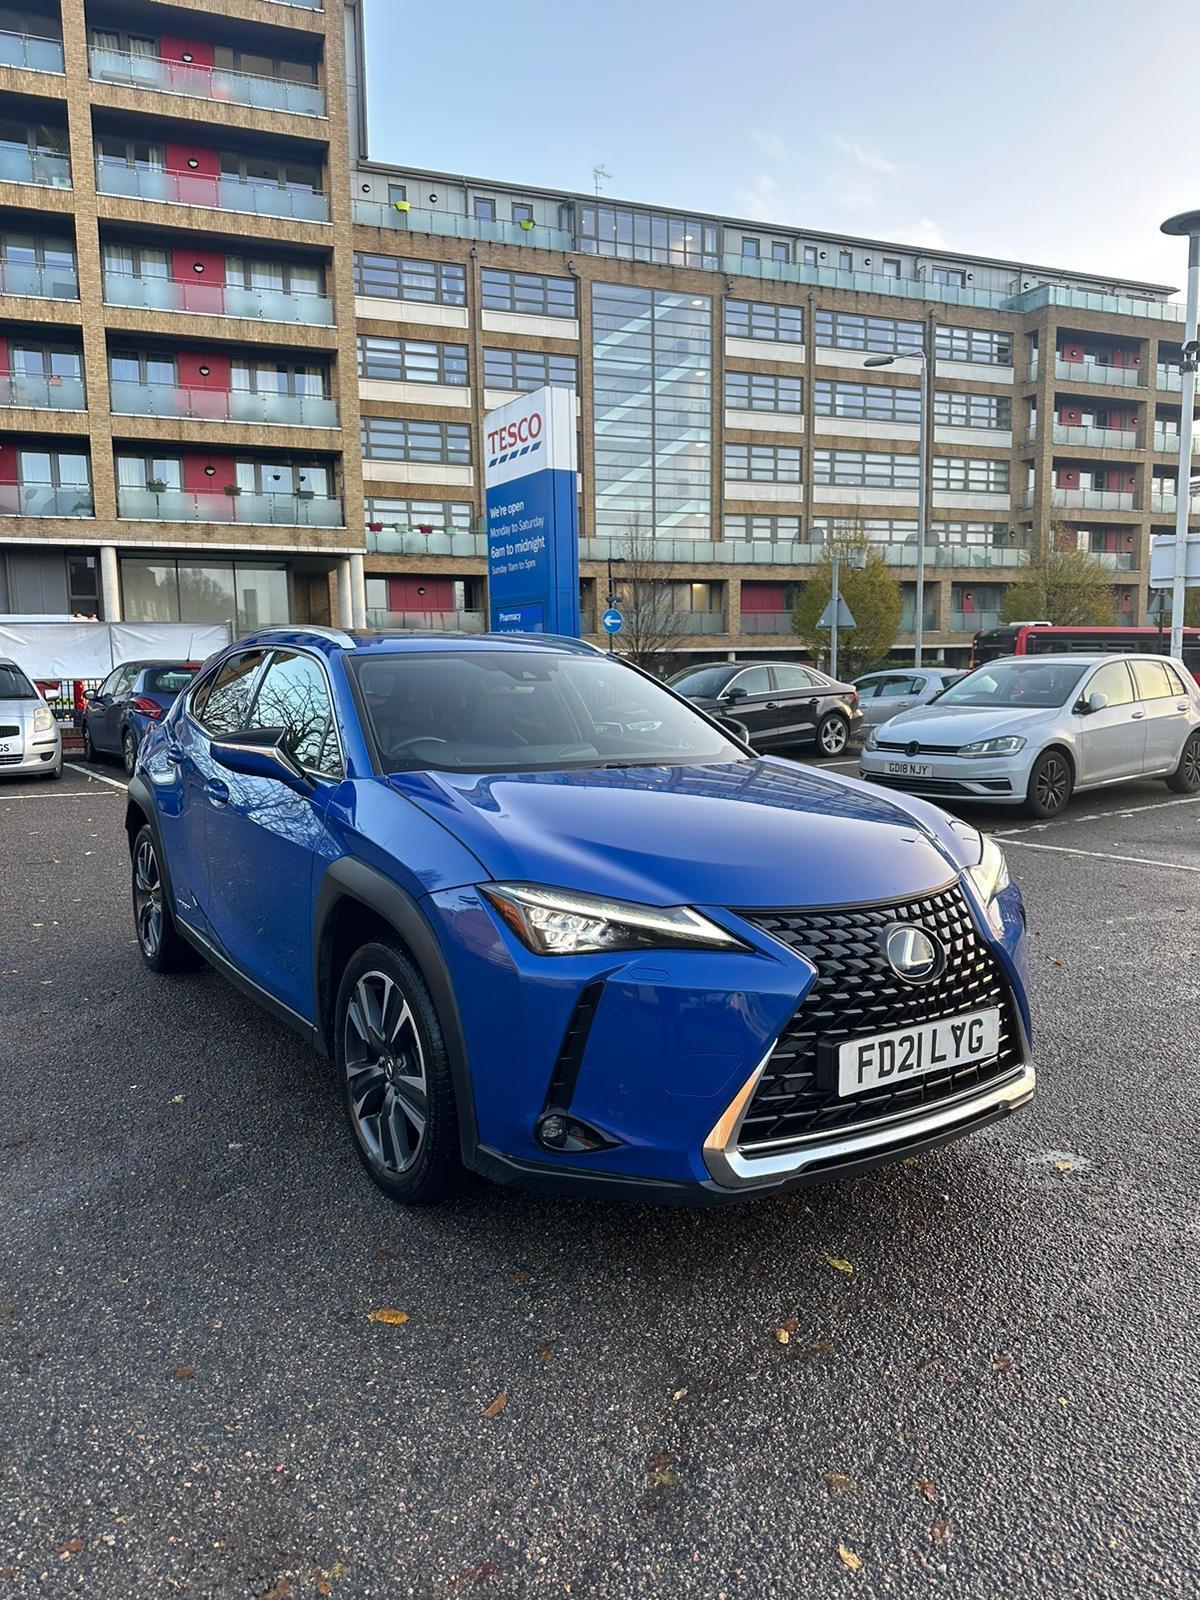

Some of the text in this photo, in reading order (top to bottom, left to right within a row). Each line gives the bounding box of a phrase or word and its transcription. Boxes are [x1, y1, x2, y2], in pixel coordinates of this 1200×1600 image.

[488, 413, 542, 454] TESCO
[490, 501, 524, 519] We're open
[490, 516, 545, 538] Monday to Saturday
[491, 535, 545, 559] 6am to midnight
[491, 565, 507, 575] Sunday
[518, 561, 525, 570] to
[525, 559, 536, 570] 5pm
[499, 612, 521, 623] Pharmacy
[889, 762, 928, 775] GD18 NJY
[857, 1018, 984, 1084] FD21 LYG
